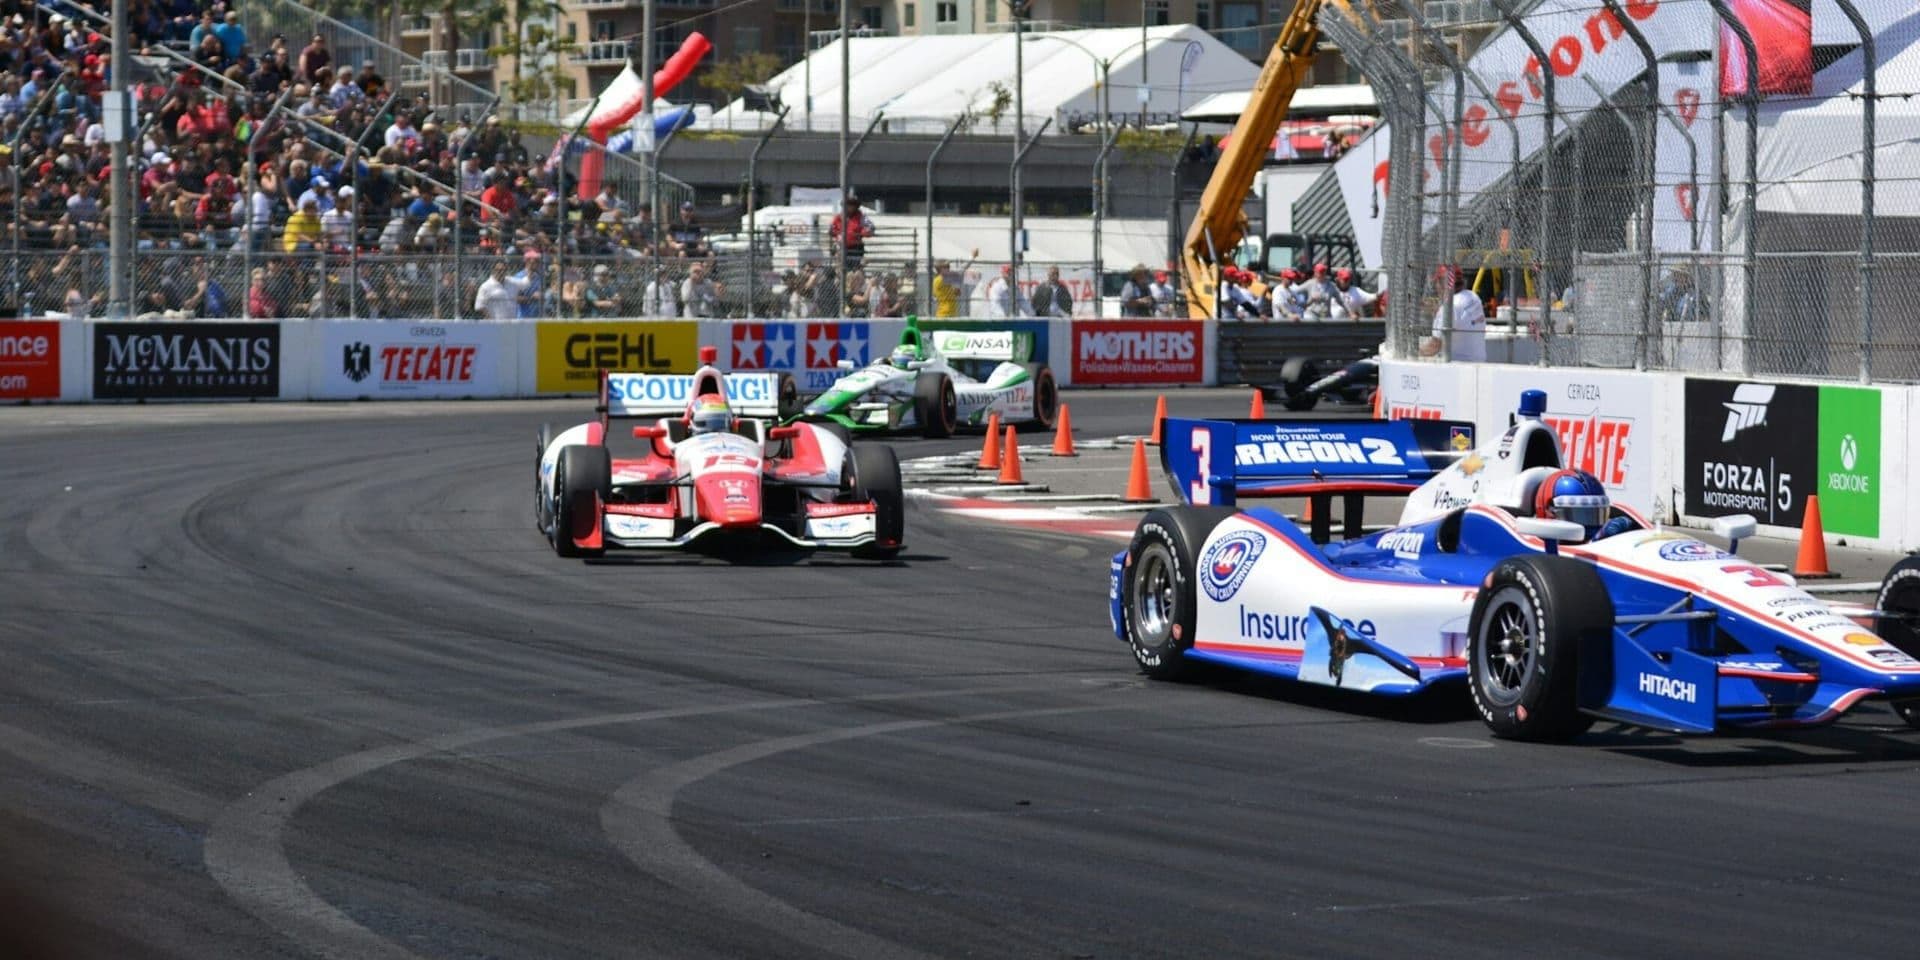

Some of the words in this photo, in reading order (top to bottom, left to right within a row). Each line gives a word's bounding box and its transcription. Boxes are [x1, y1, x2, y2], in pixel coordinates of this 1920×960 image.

[410, 327, 447, 337] CERVEZA
[1080, 331, 1195, 360] MOTHERS
[0, 335, 48, 357] nce
[565, 333, 671, 368] GEHL
[381, 344, 476, 381] TECATE
[0, 375, 27, 389] om
[105, 375, 164, 384] FAMILY
[177, 375, 269, 384] VINEYARDS
[609, 378, 769, 400] SCOUNG!
[1568, 383, 1600, 400] CERVEZA
[1236, 443, 1367, 465] RAGON
[1361, 438, 1405, 465] 2
[1191, 428, 1212, 504] 3
[1704, 462, 1766, 493] FORZA
[1778, 473, 1792, 511] 5
[1850, 474, 1869, 493] ONE
[1215, 544, 1243, 568] AAA
[1376, 528, 1424, 559] verizon
[1639, 672, 1697, 704] HITACHI
